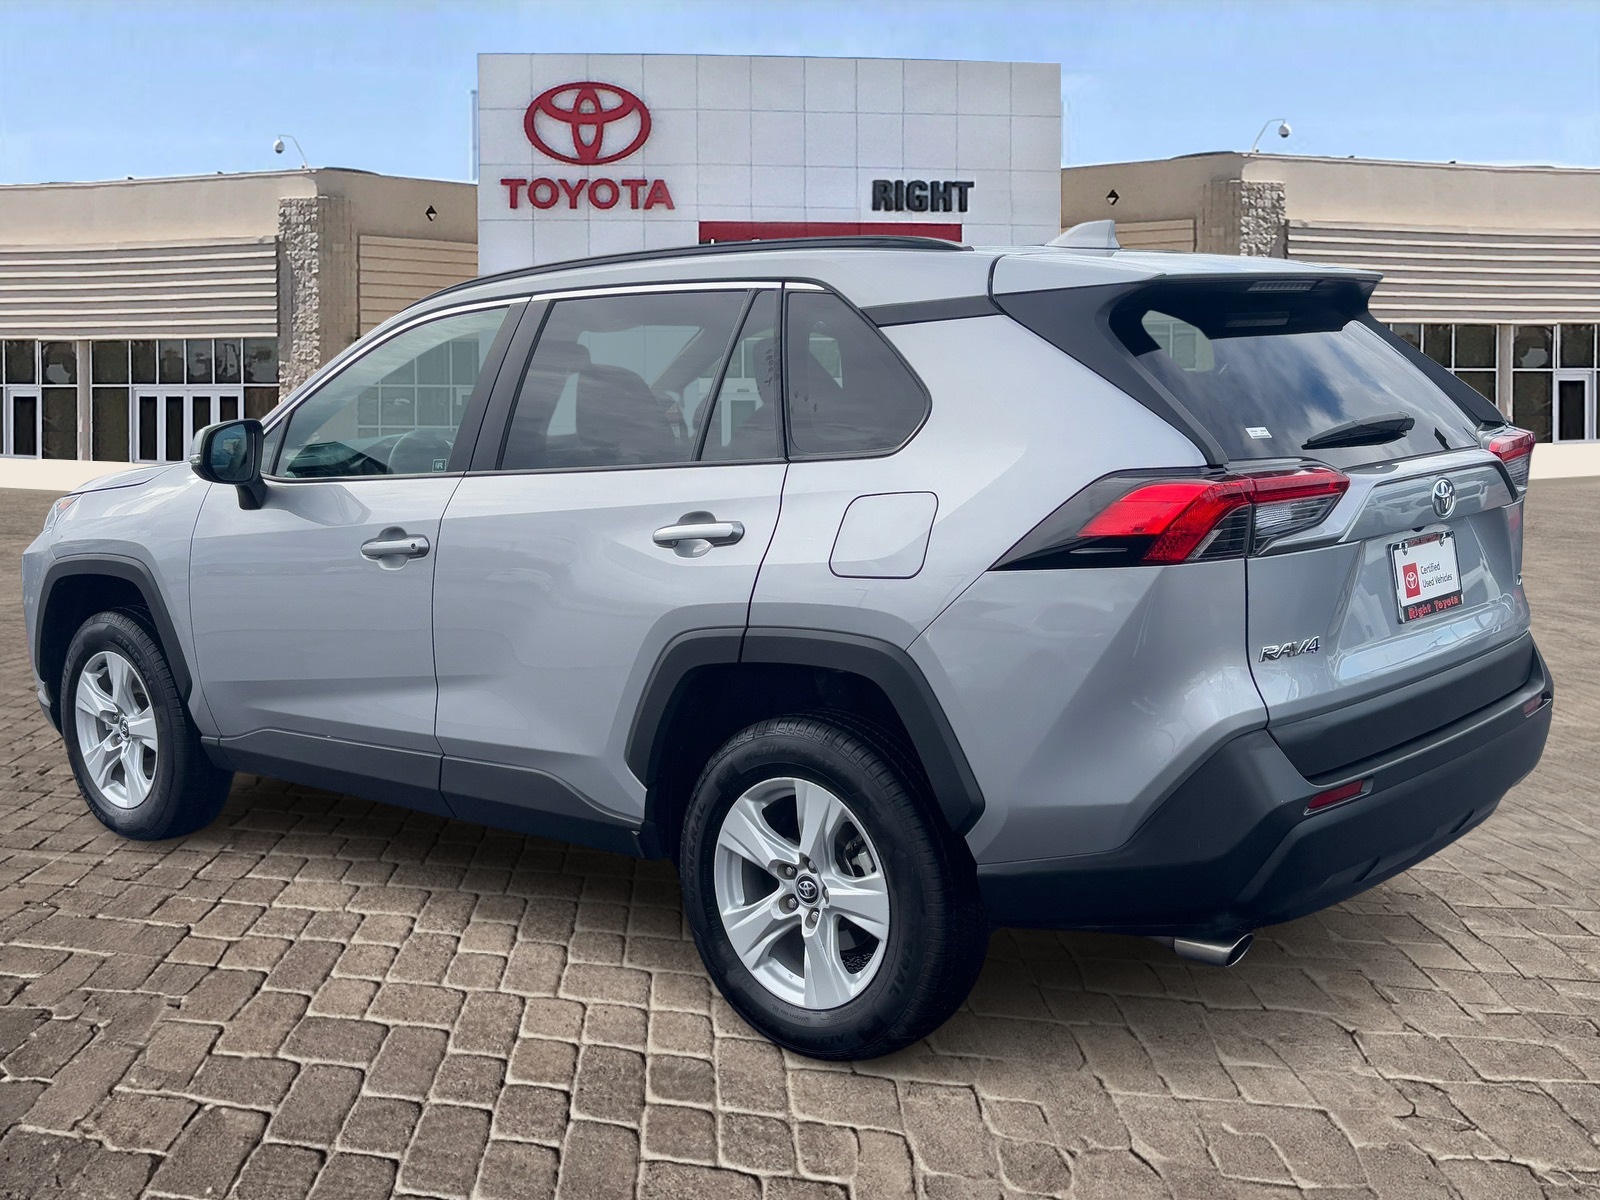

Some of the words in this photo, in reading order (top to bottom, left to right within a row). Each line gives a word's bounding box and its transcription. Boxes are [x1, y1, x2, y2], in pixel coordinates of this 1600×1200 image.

[501, 179, 675, 211] TOYOTA
[872, 180, 975, 213] RIGHT
[1420, 562, 1440, 575] Certified
[1422, 578, 1434, 588] Used
[1435, 573, 1453, 585] Vehicles
[1408, 604, 1432, 619] Right
[1434, 595, 1459, 611] Toyota
[1259, 635, 1321, 663] RAV4
